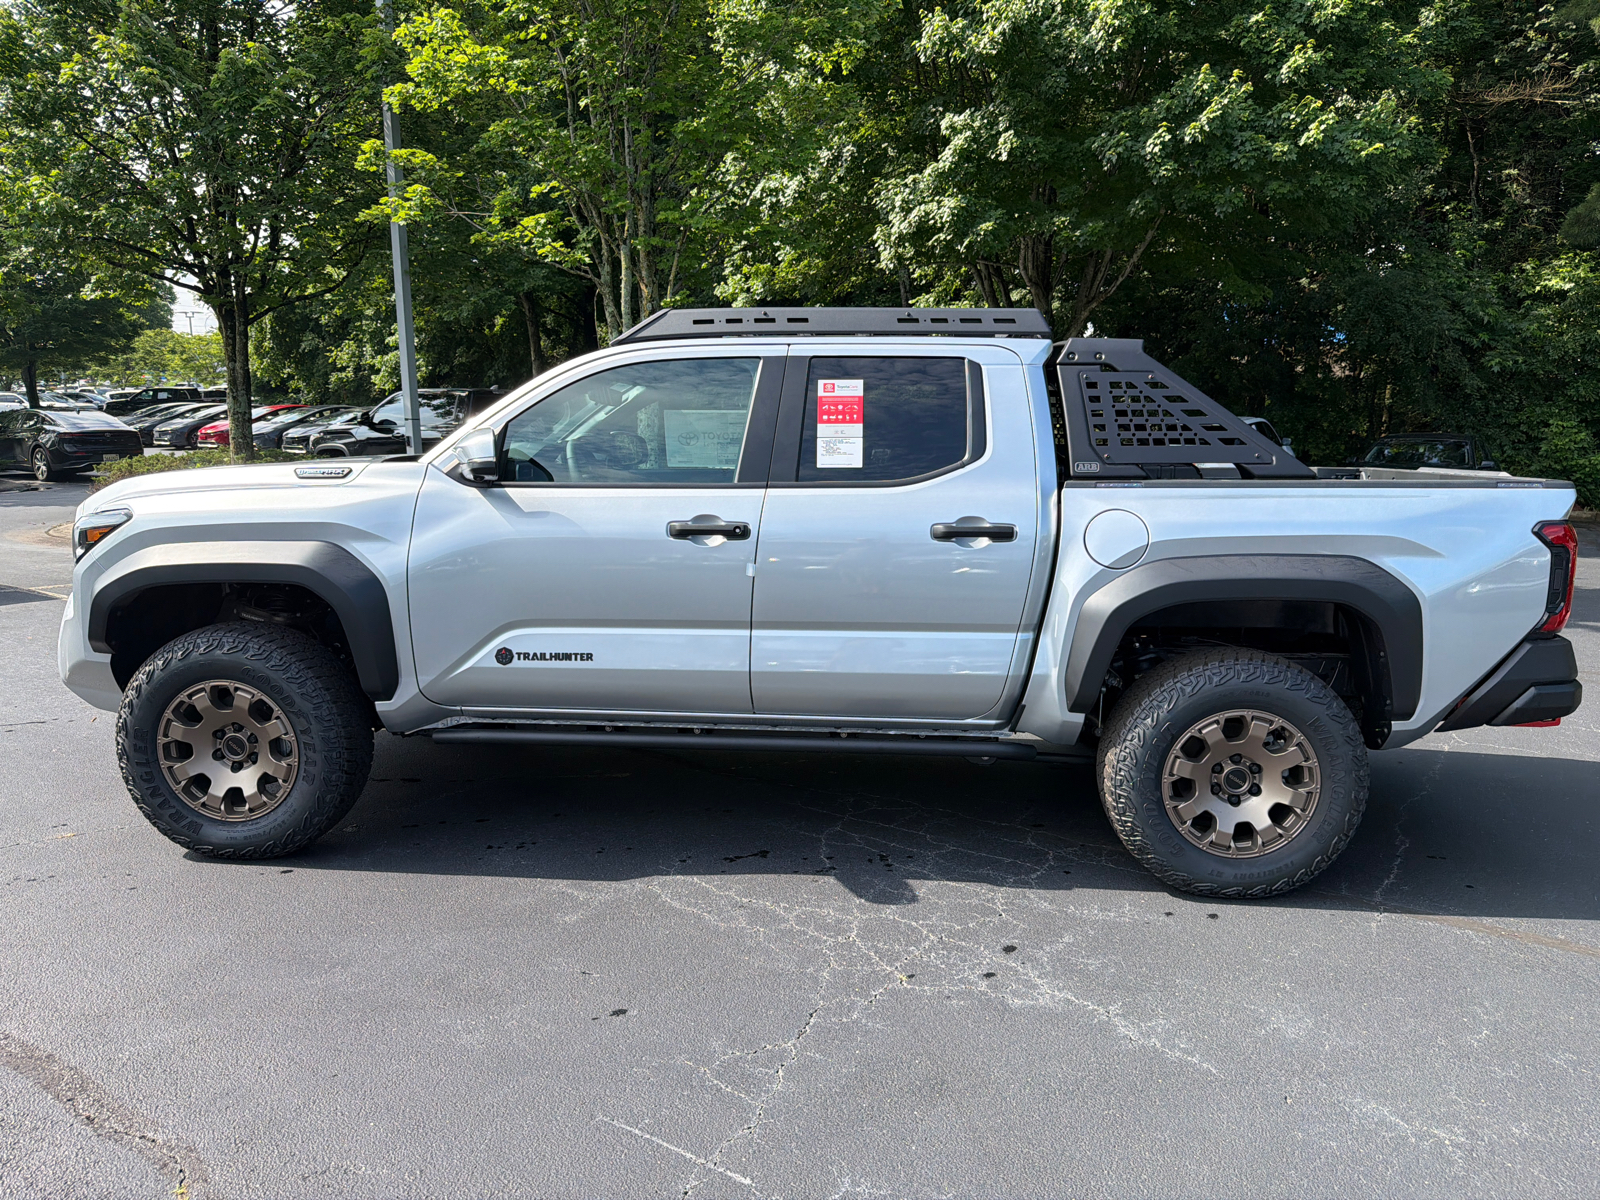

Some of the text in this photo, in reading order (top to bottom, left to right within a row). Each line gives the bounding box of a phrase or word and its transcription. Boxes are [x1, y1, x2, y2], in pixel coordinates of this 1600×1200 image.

[1077, 463, 1098, 471] ARB
[515, 651, 594, 662] TRAILHUNTER
[133, 727, 204, 836] WRANGLER
[241, 666, 317, 787] GOODYEAR
[1306, 715, 1346, 845] WRANGLER
[1141, 721, 1185, 858] GOODYEAR
